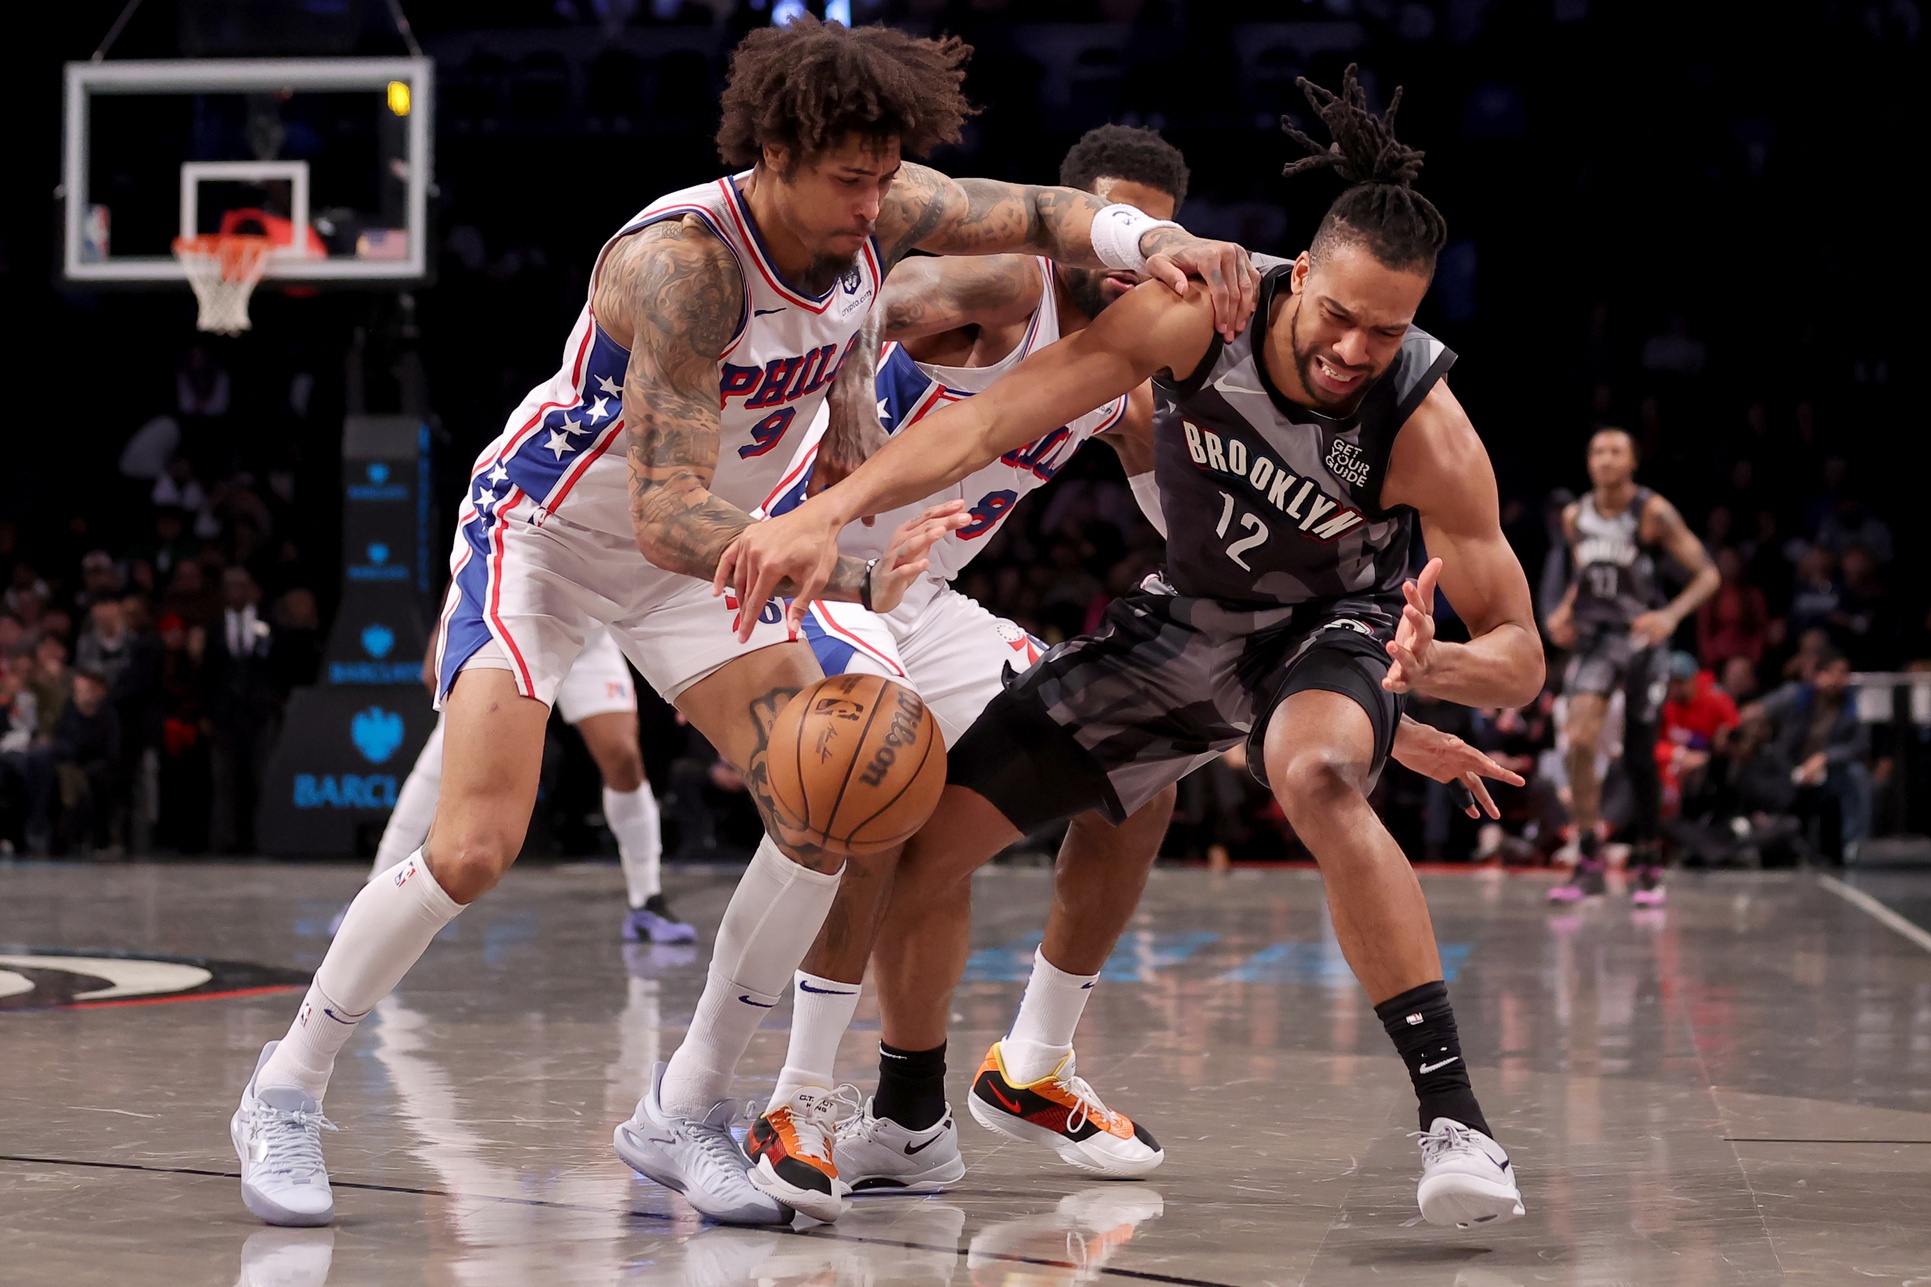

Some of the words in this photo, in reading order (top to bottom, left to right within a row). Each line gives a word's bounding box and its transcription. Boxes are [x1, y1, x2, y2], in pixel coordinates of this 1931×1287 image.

[738, 406, 797, 460] 9
[1333, 439, 1363, 458] GET
[1325, 455, 1367, 488] GUIDE
[1331, 446, 1370, 476] YOUR
[1182, 419, 1366, 543] BROOKLYN
[1215, 490, 1269, 572] 12
[294, 773, 399, 809] BARCL
